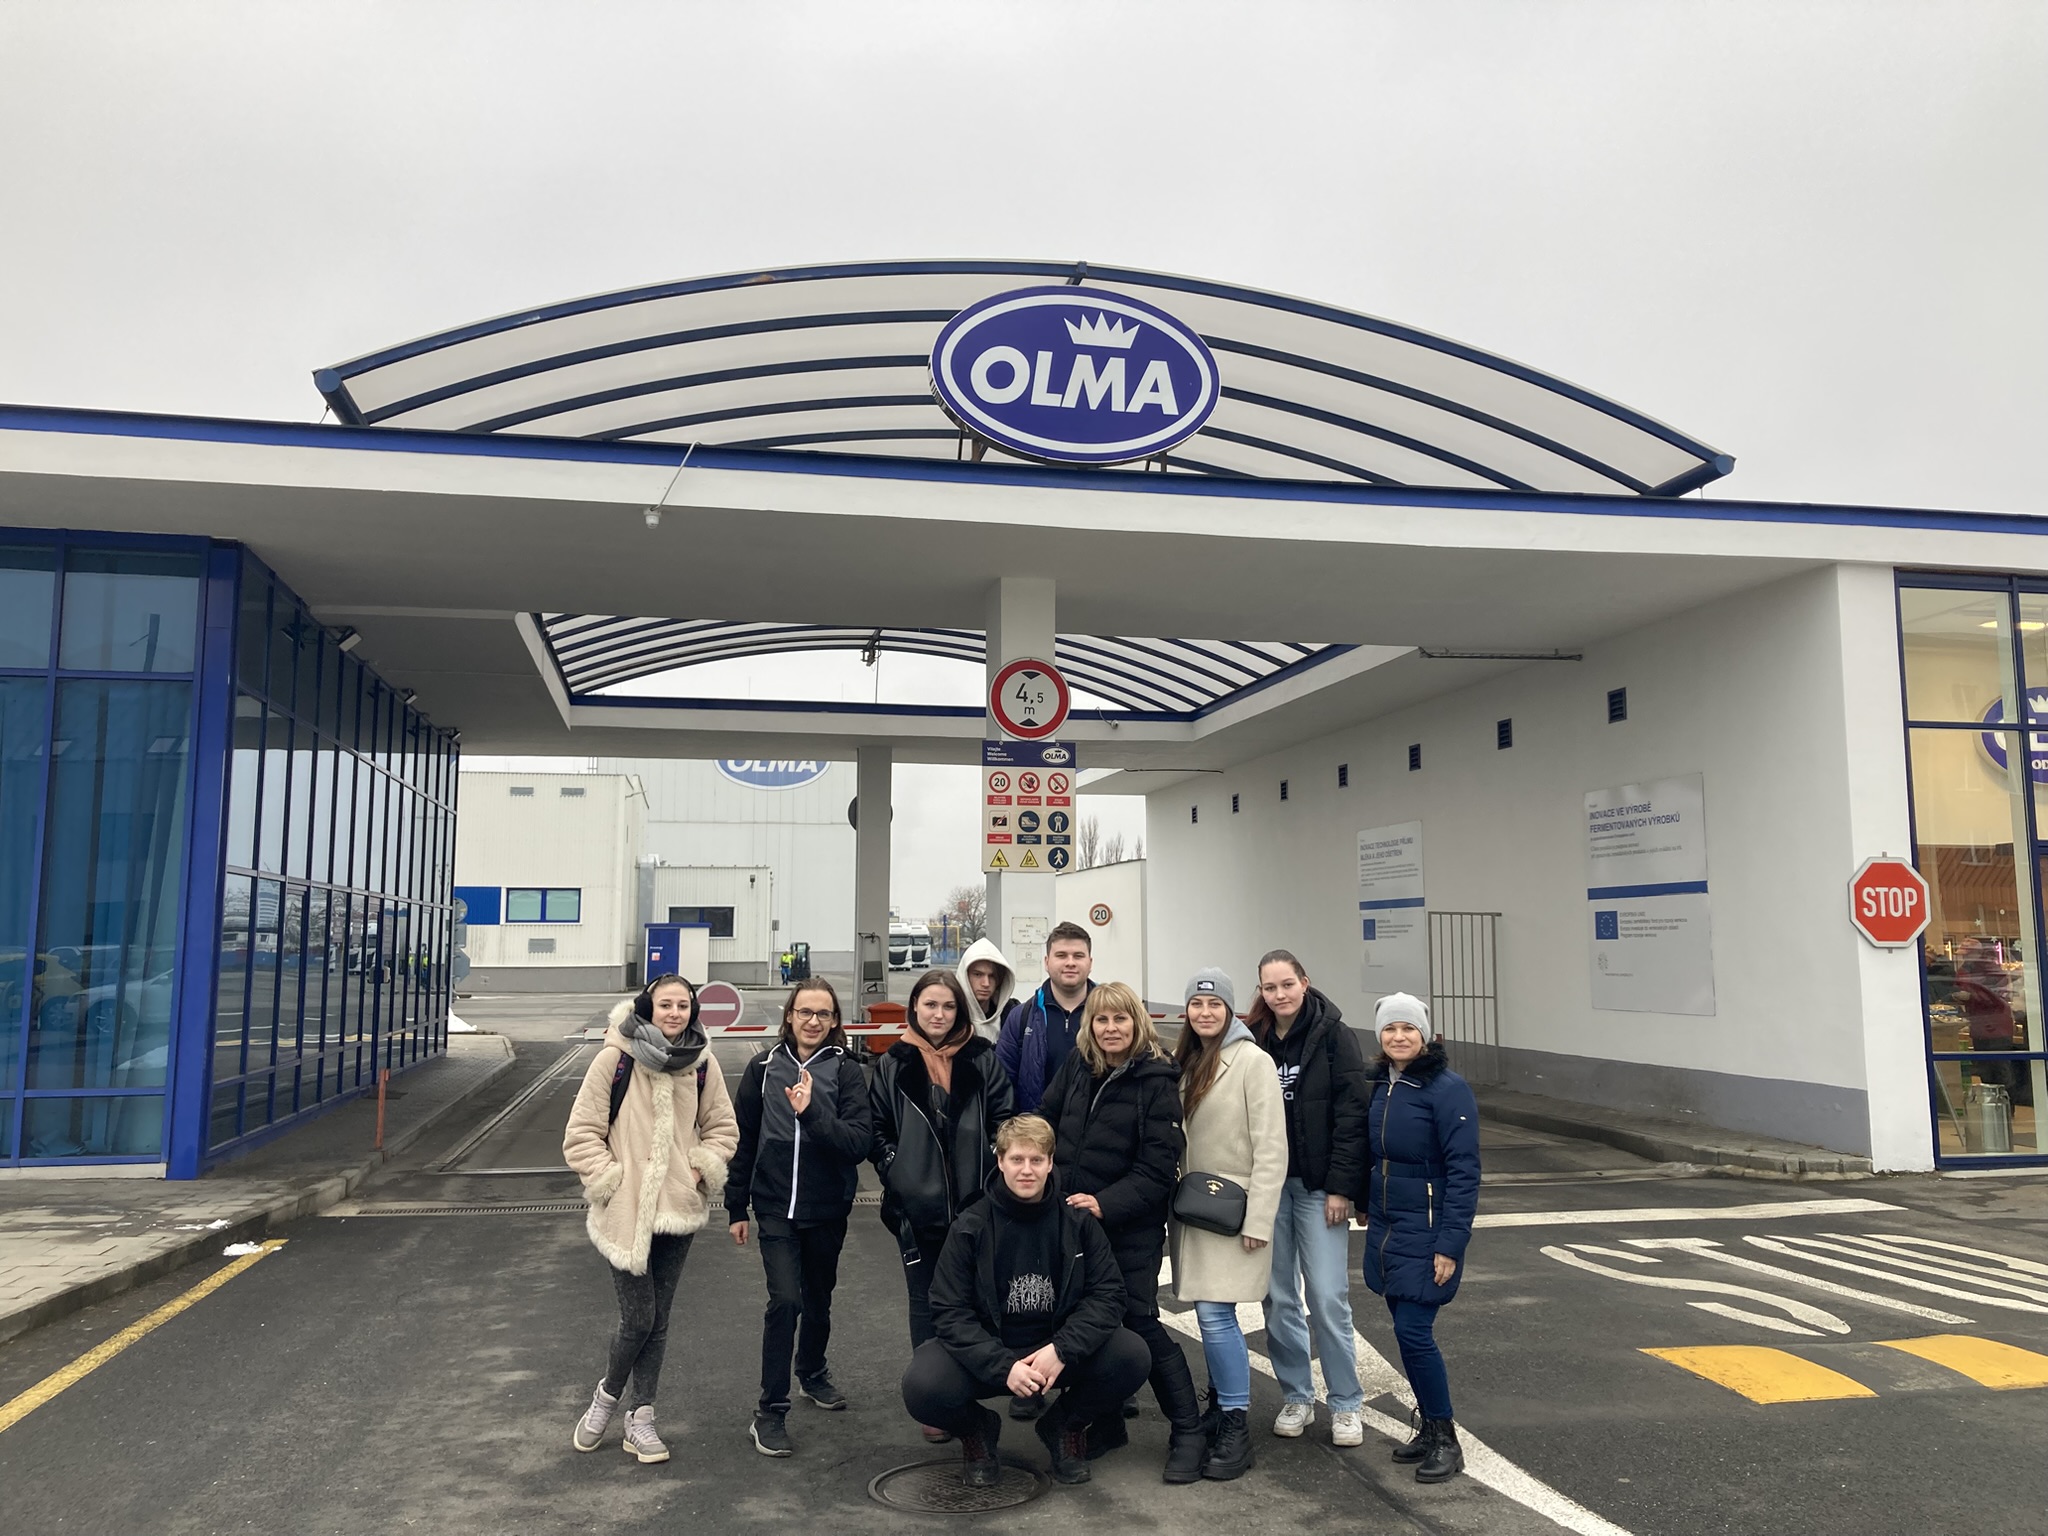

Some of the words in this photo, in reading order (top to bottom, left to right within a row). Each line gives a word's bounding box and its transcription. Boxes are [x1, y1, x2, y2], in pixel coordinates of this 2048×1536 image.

[970, 345, 1180, 416] OLMA
[1024, 706, 1035, 715] m
[1044, 752, 1067, 760] OLMA
[994, 778, 1006, 787] 20
[1589, 808, 1615, 820] INOVACE
[1616, 807, 1625, 816] VE
[1862, 886, 1918, 918] STOP
[1094, 909, 1107, 920] 20
